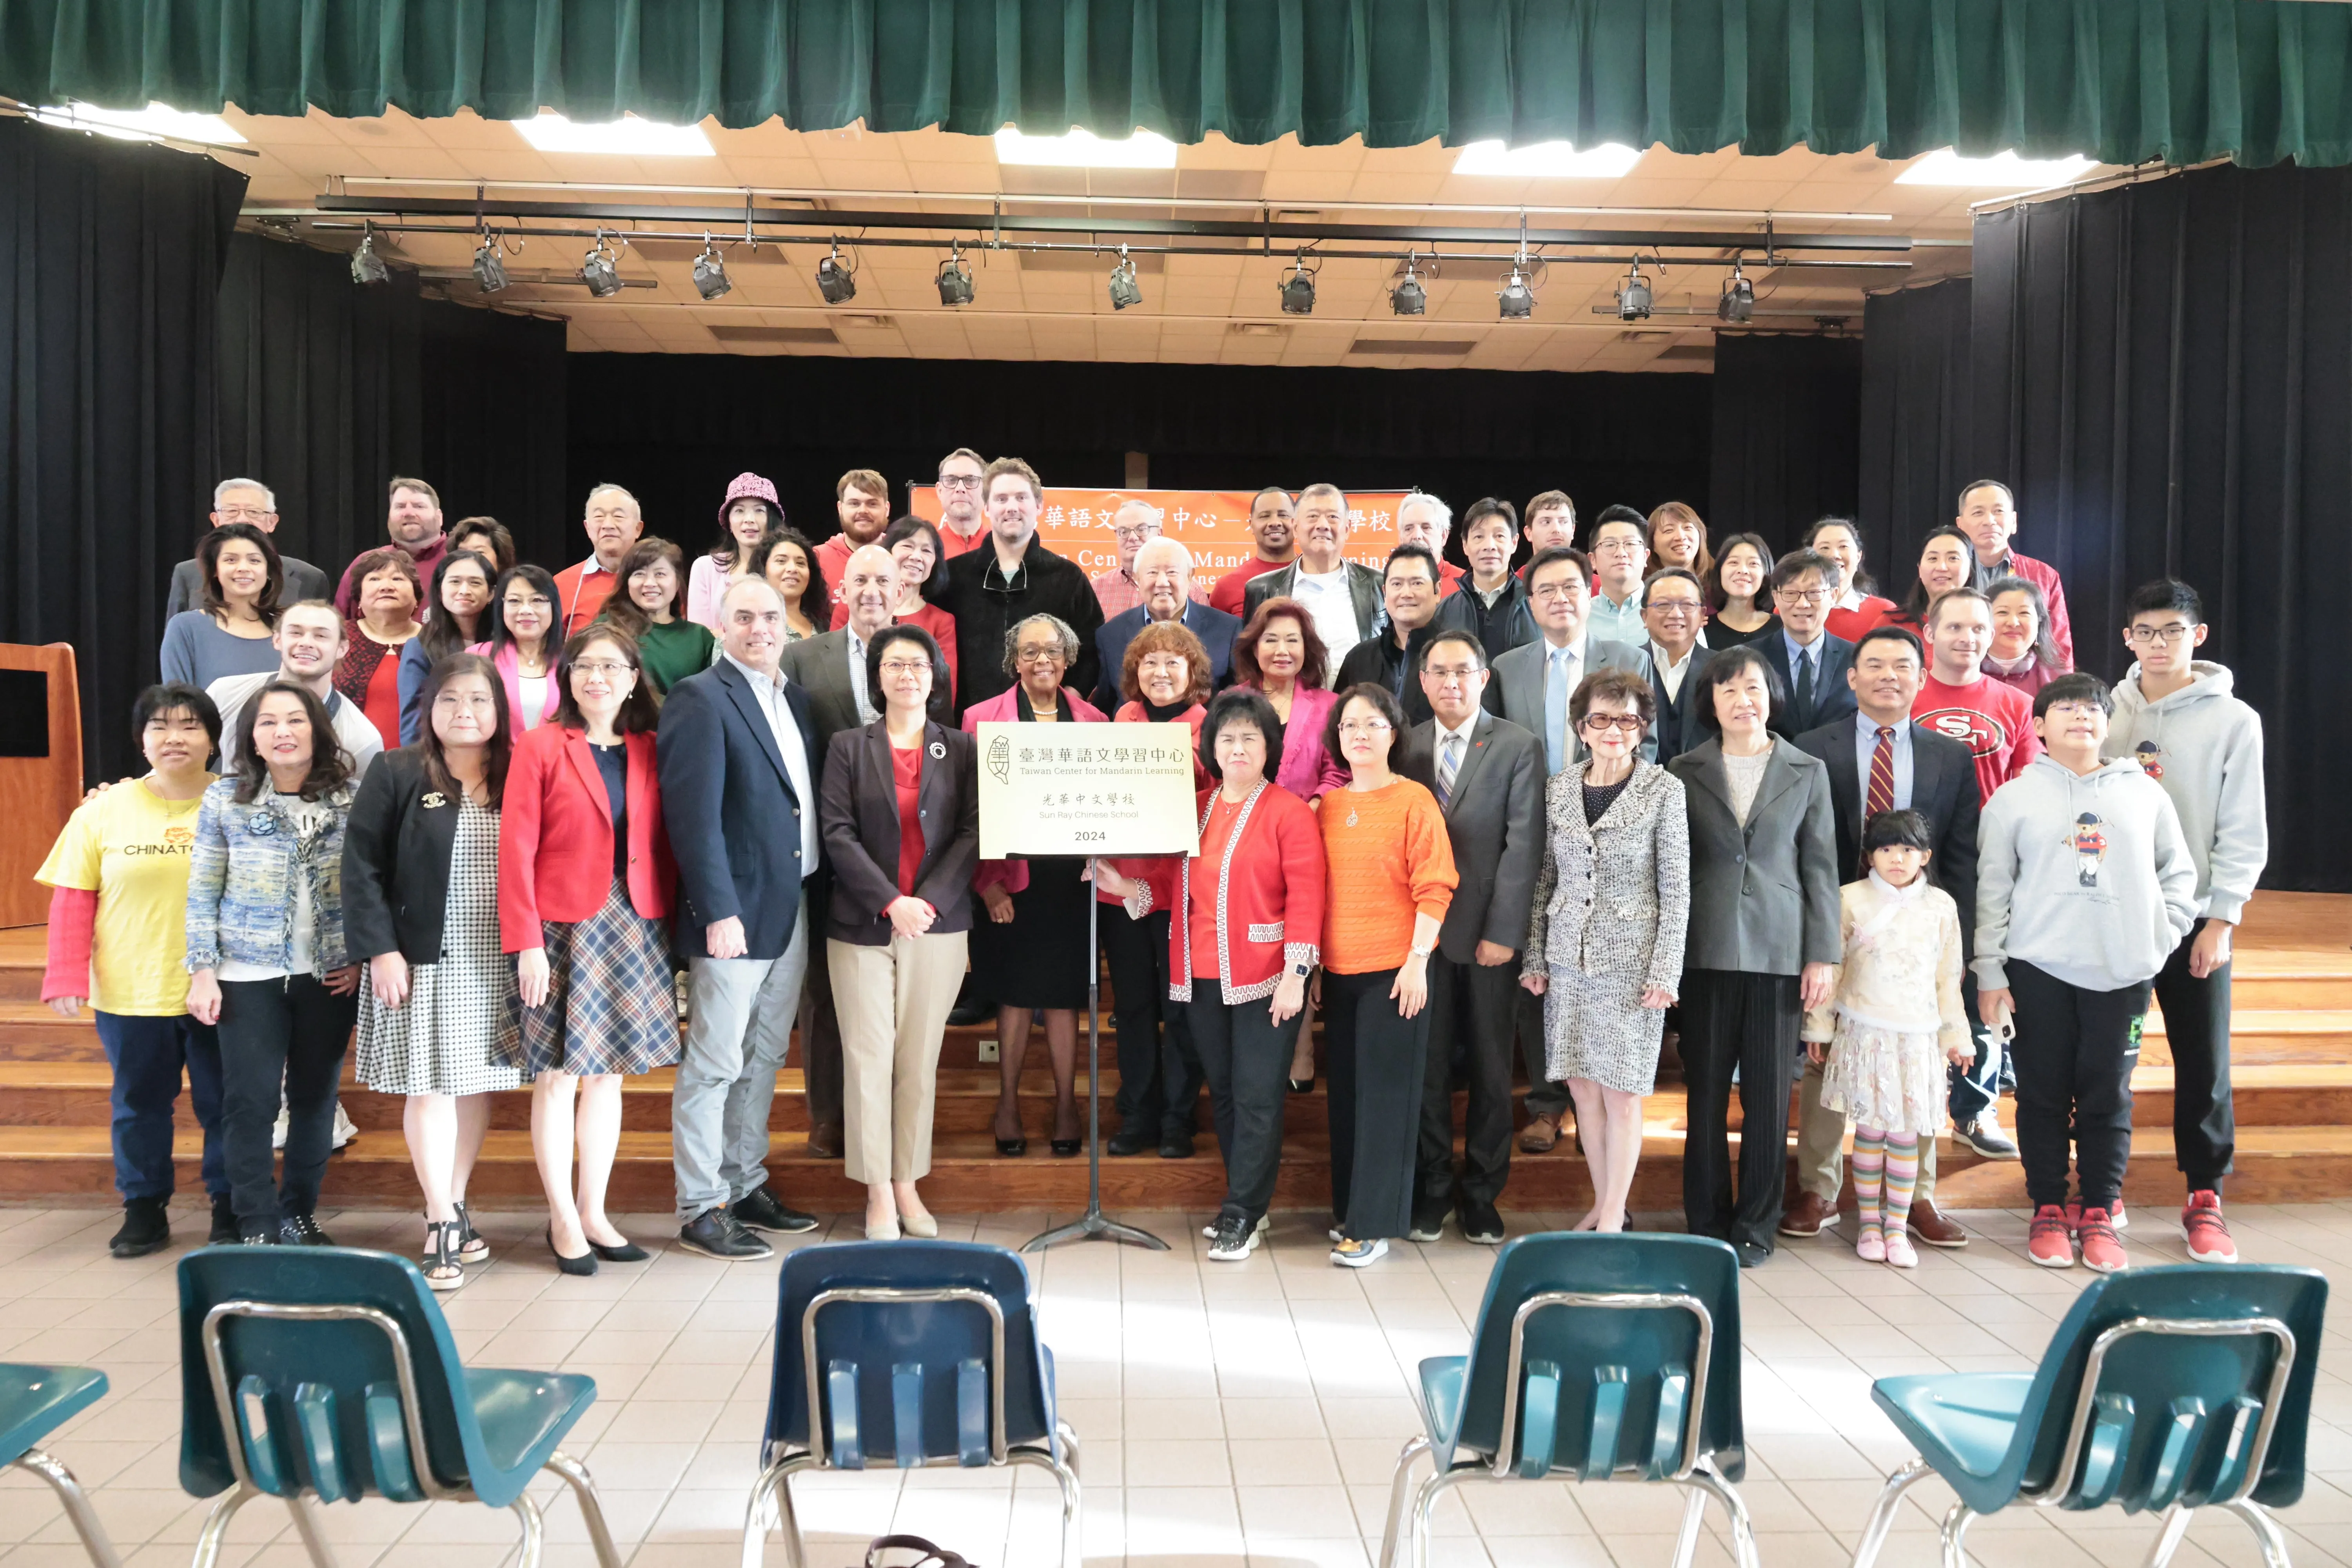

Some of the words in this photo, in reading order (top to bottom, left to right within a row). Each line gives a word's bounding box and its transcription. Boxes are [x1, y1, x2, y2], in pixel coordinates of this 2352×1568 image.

[1078, 550, 1116, 566] Cen
[1194, 552, 1249, 567] Mand
[1020, 748, 1184, 762] 臺灣華語文學習中心
[1145, 767, 1184, 776] Learning
[1042, 792, 1135, 806] 光華中文學校
[1075, 831, 1106, 841] 2024
